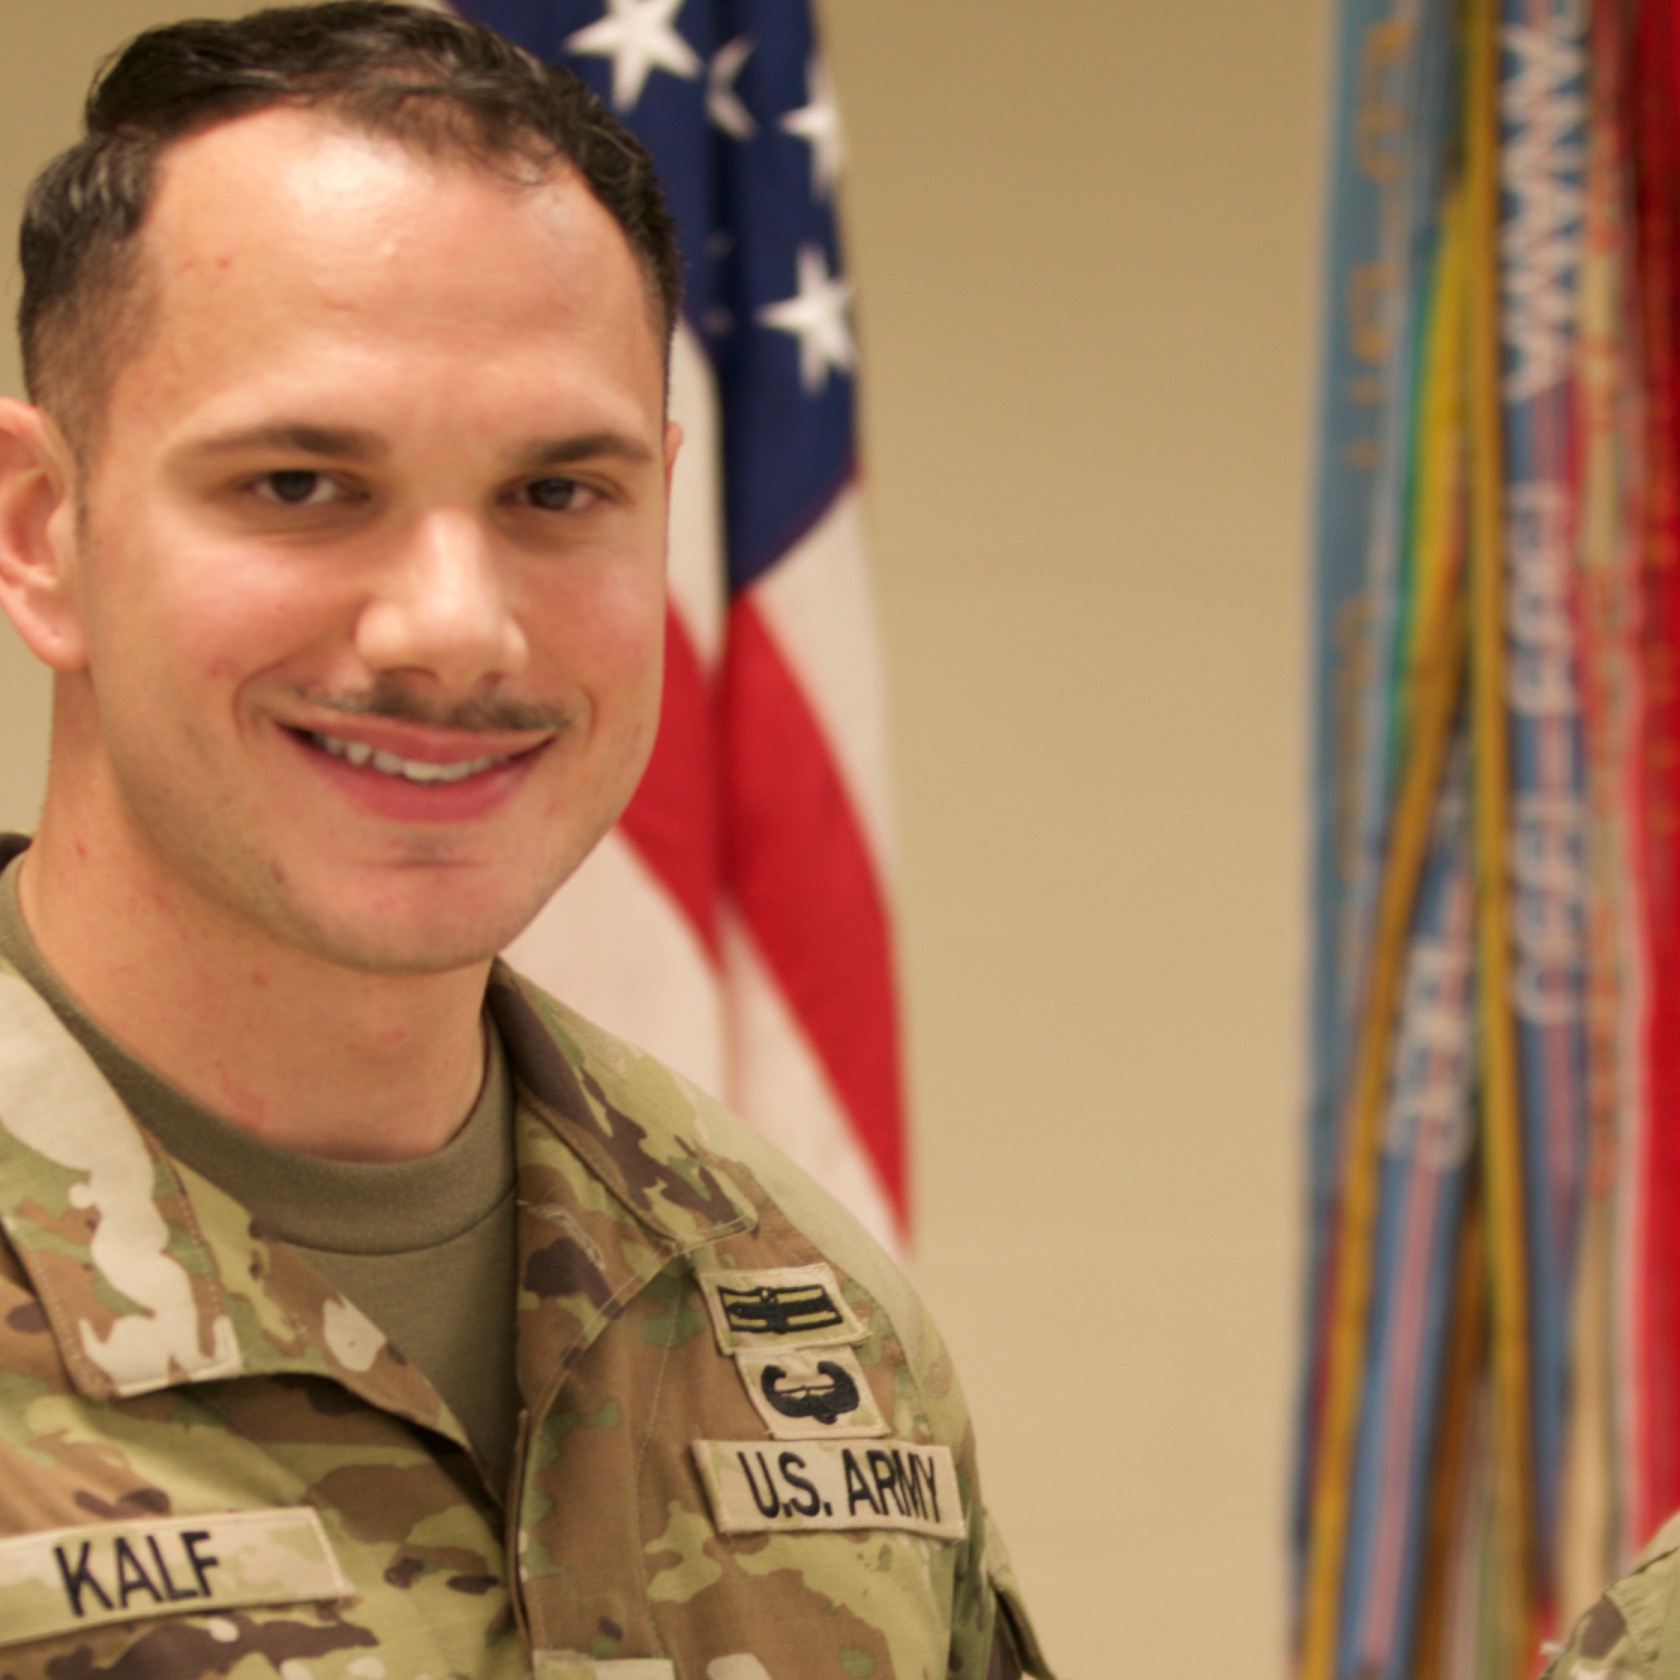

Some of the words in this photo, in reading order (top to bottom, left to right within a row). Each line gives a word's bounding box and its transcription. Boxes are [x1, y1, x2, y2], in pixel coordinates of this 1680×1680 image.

[738, 1450, 833, 1519] U.S.
[842, 1447, 941, 1522] ARMY
[53, 1529, 219, 1616] KALF
